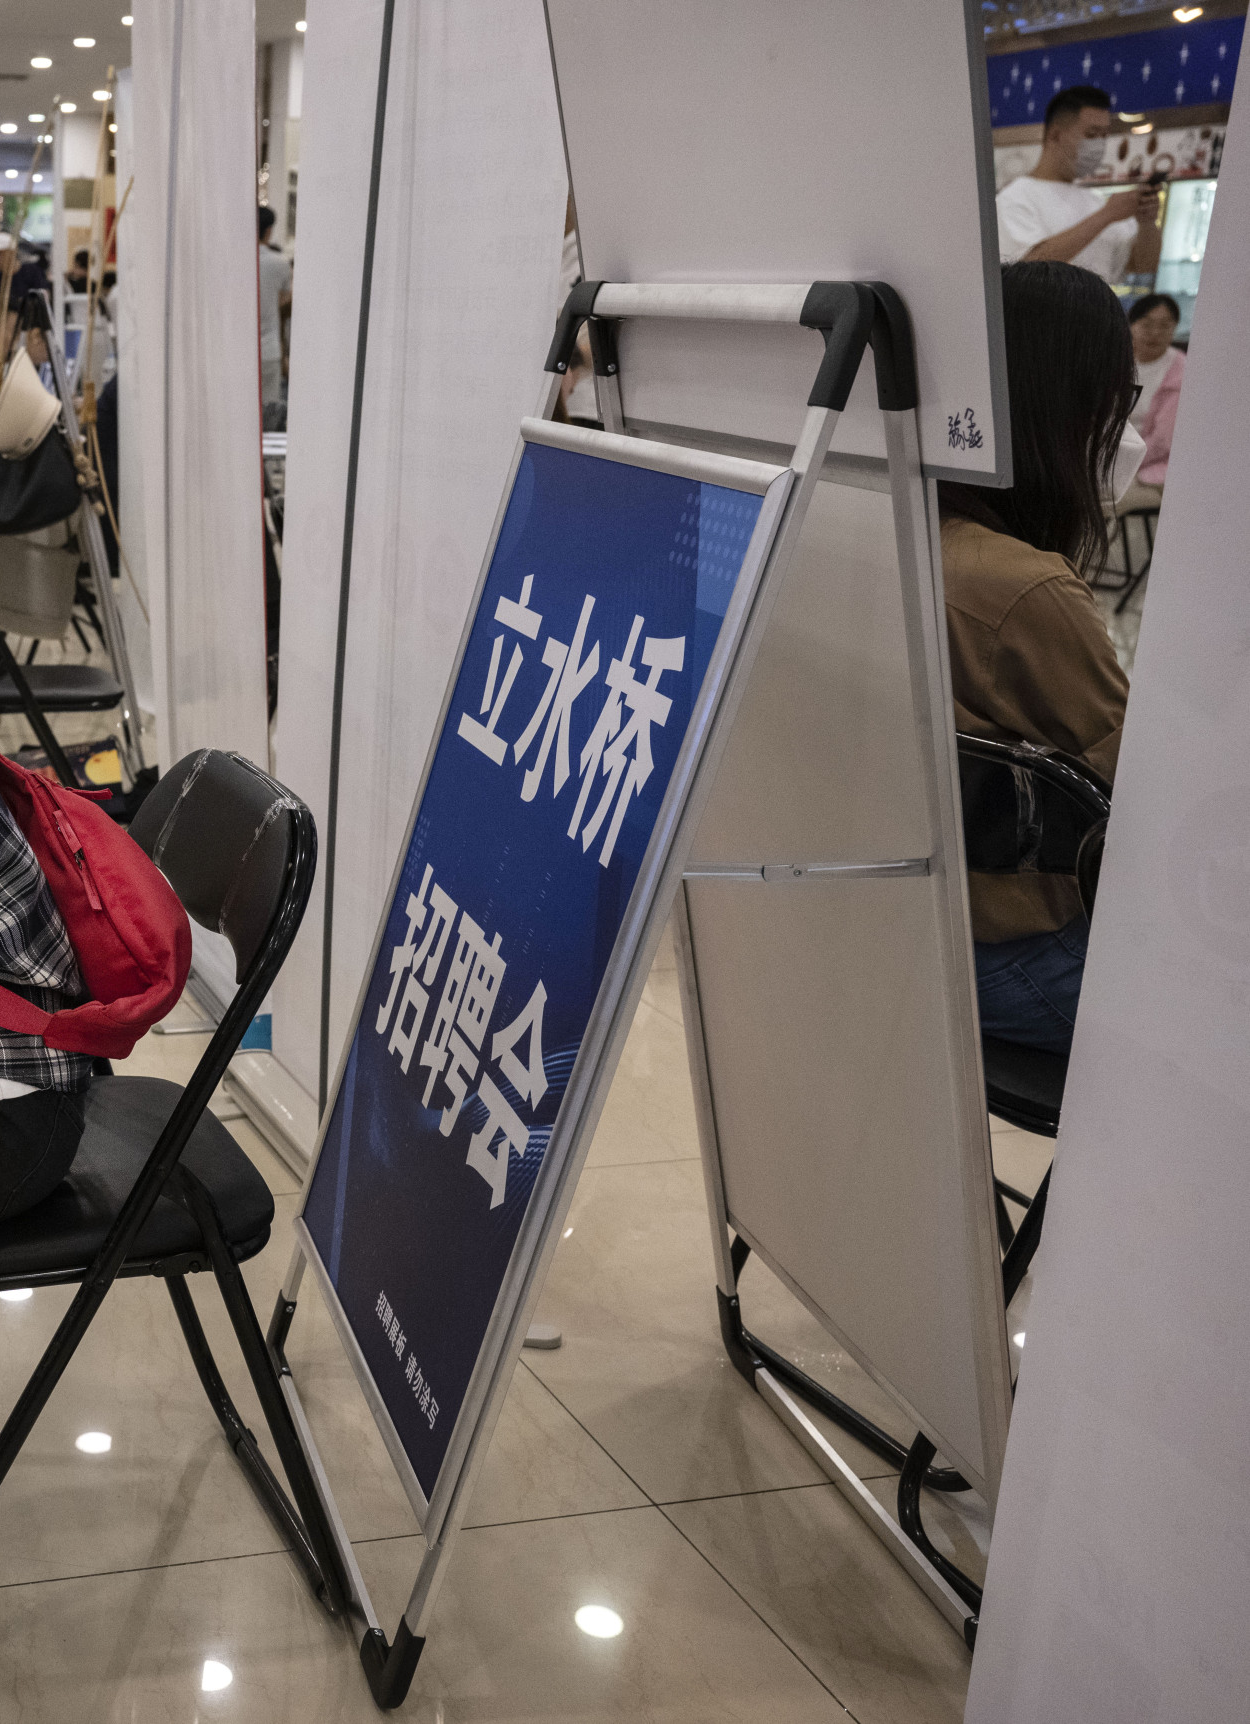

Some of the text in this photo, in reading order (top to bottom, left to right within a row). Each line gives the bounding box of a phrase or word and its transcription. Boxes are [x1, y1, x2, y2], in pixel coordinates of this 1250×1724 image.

[457, 573, 686, 869] 立水桥
[375, 862, 549, 1210] 招聘会
[375, 1289, 440, 1430] 招聘展板 请勿涂写
